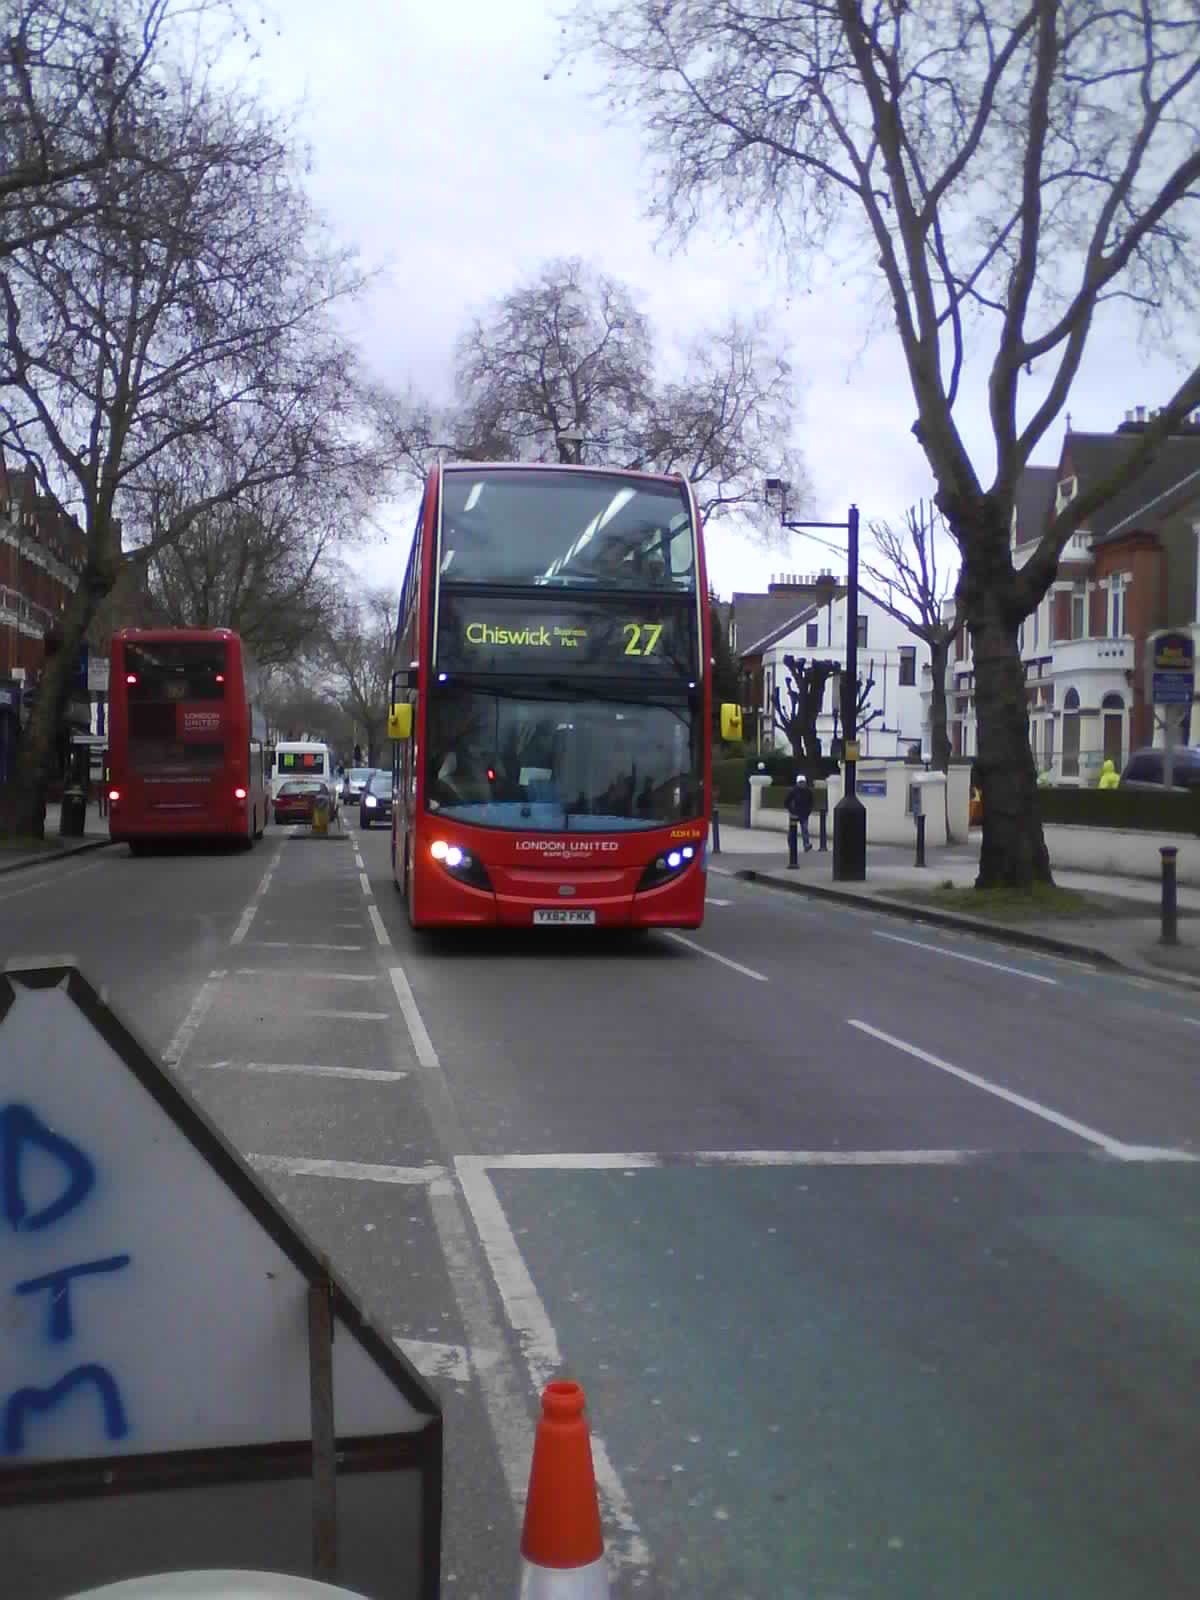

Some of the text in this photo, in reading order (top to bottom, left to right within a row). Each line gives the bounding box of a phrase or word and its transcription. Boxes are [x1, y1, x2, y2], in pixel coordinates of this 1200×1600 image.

[466, 622, 663, 656] Chiswick 27
[515, 840, 619, 852] LONDON UNITED
[14, 1253, 130, 1342] T
